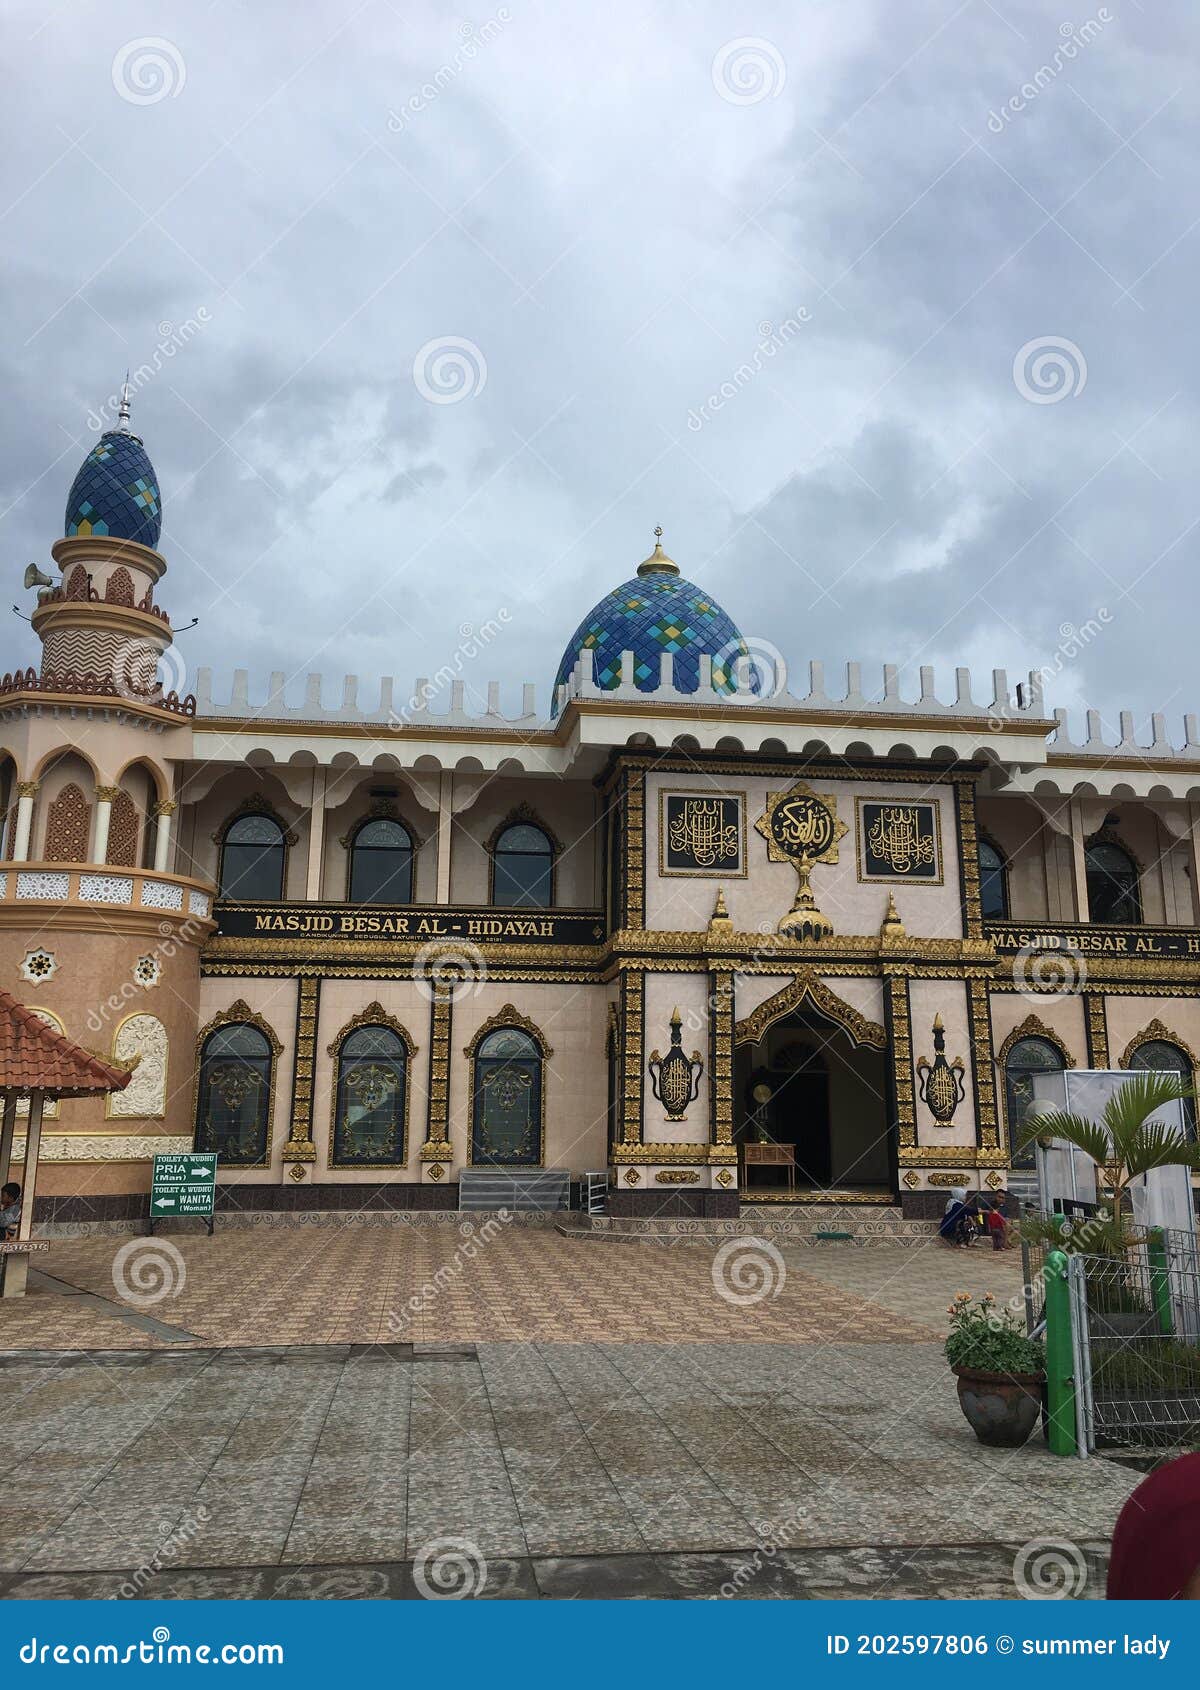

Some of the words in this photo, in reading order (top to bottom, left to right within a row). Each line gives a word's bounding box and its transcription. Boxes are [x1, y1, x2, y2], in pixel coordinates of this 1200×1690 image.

[254, 915, 333, 931] MASJID
[340, 917, 409, 933] BESAR
[416, 919, 447, 934] AL
[467, 920, 554, 936] HIDAYAH
[990, 933, 1060, 949] MASJID
[1066, 935, 1128, 951] BESAR
[1135, 938, 1162, 952] AL
[156, 1164, 186, 1173] PRIA
[179, 1195, 211, 1204] WANITA
